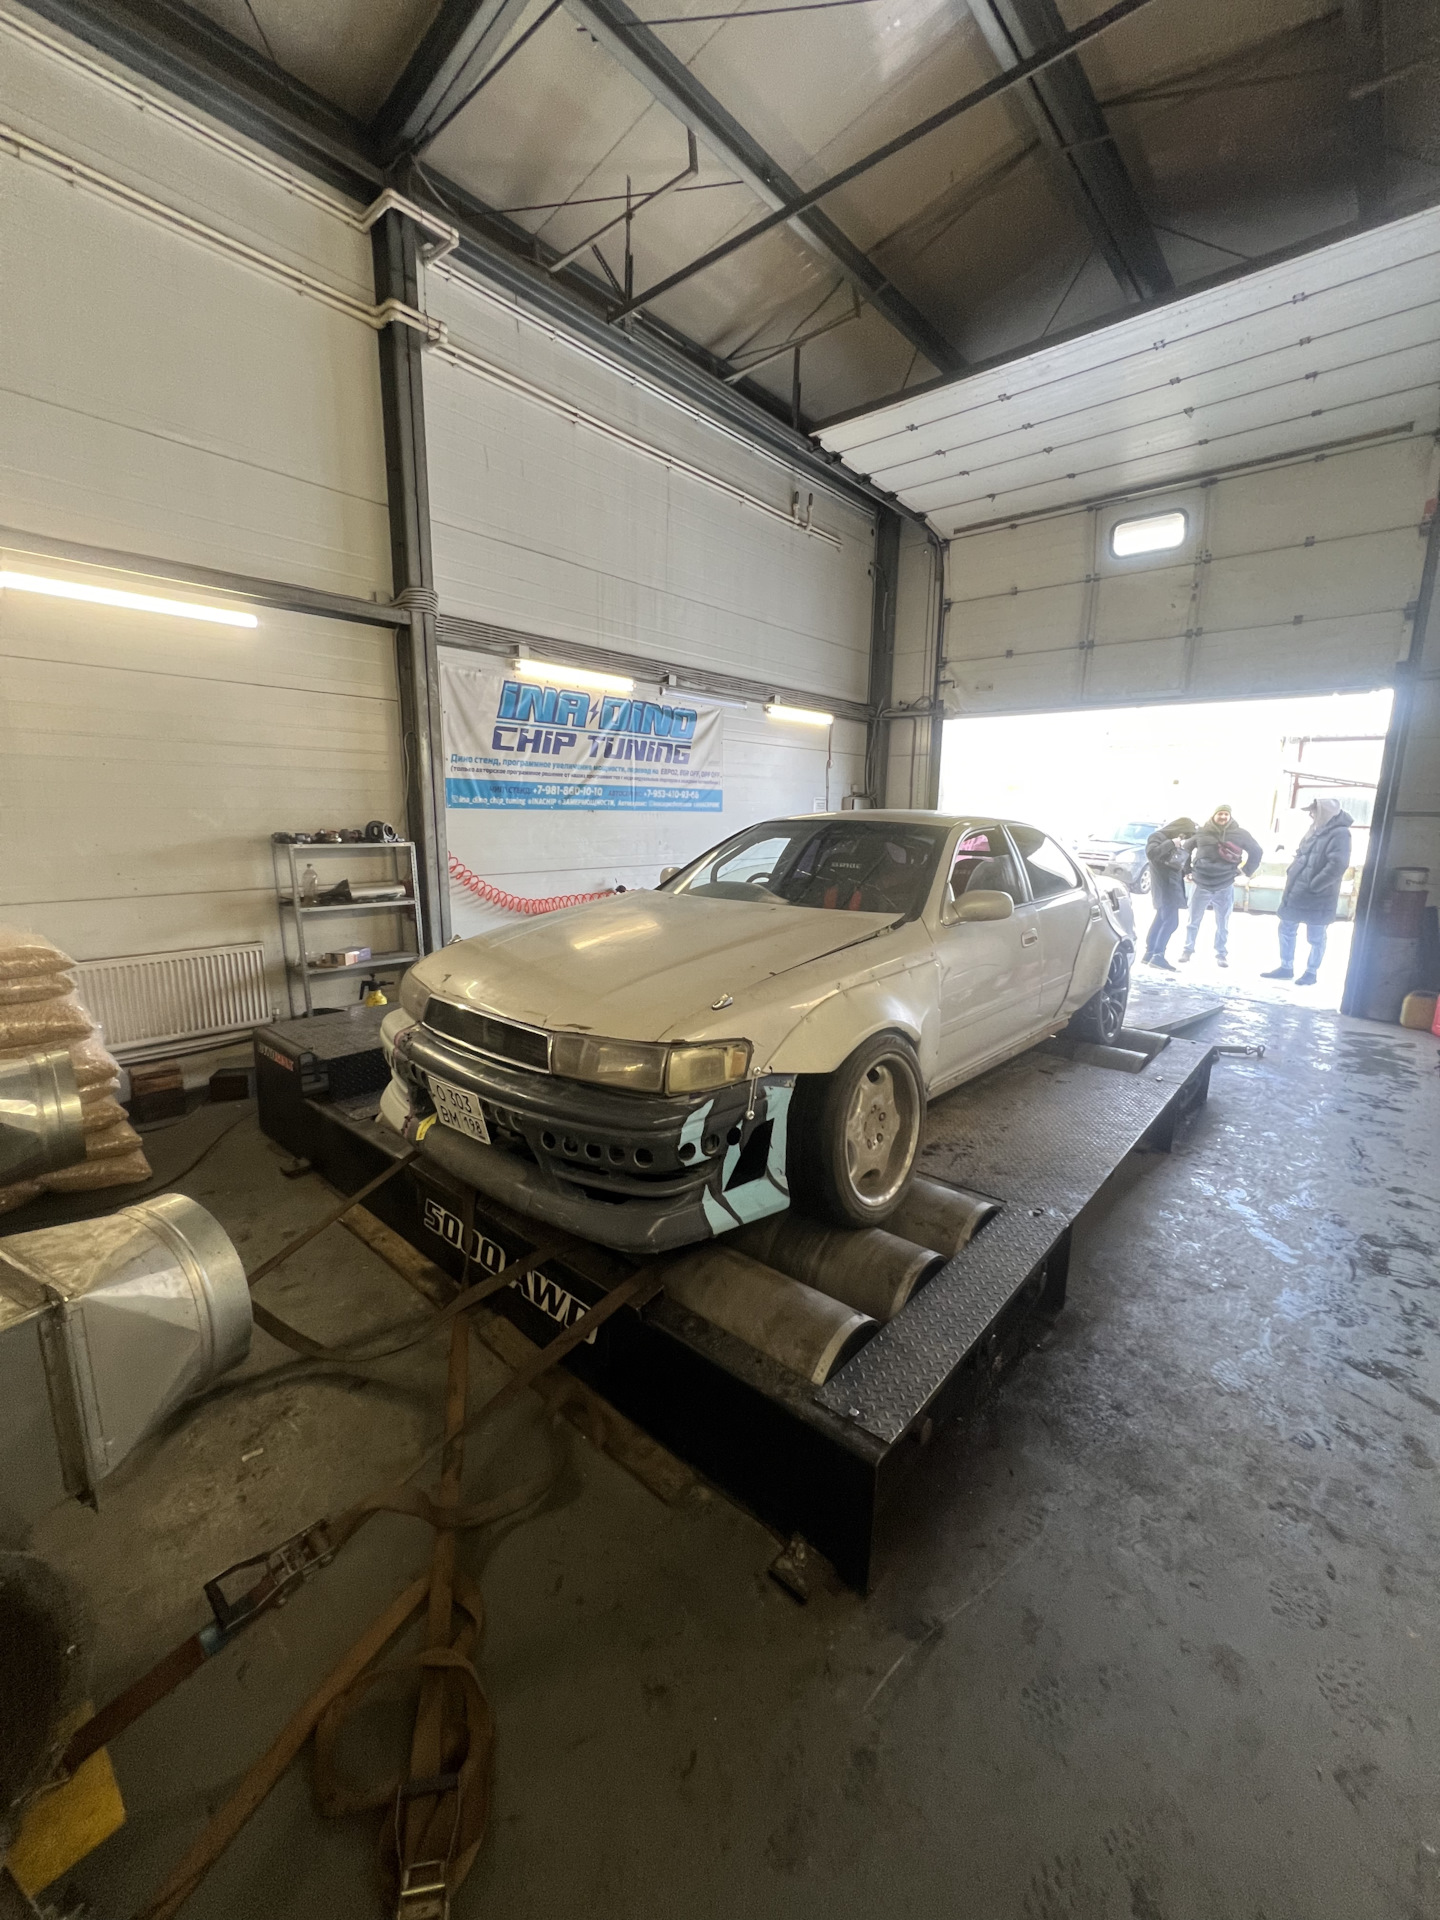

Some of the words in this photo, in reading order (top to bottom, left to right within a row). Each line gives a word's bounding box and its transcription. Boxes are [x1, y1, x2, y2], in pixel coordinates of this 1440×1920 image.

[497, 680, 590, 728] INA
[598, 696, 698, 739] DINO
[492, 726, 578, 755] CHIP
[588, 735, 692, 764] TUNING
[451, 754, 473, 764] Дино
[474, 757, 501, 766] стенд,
[533, 785, 603, 796] +7-981-860-10-10
[447, 1089, 472, 1113] 303
[464, 1116, 482, 1134] 198
